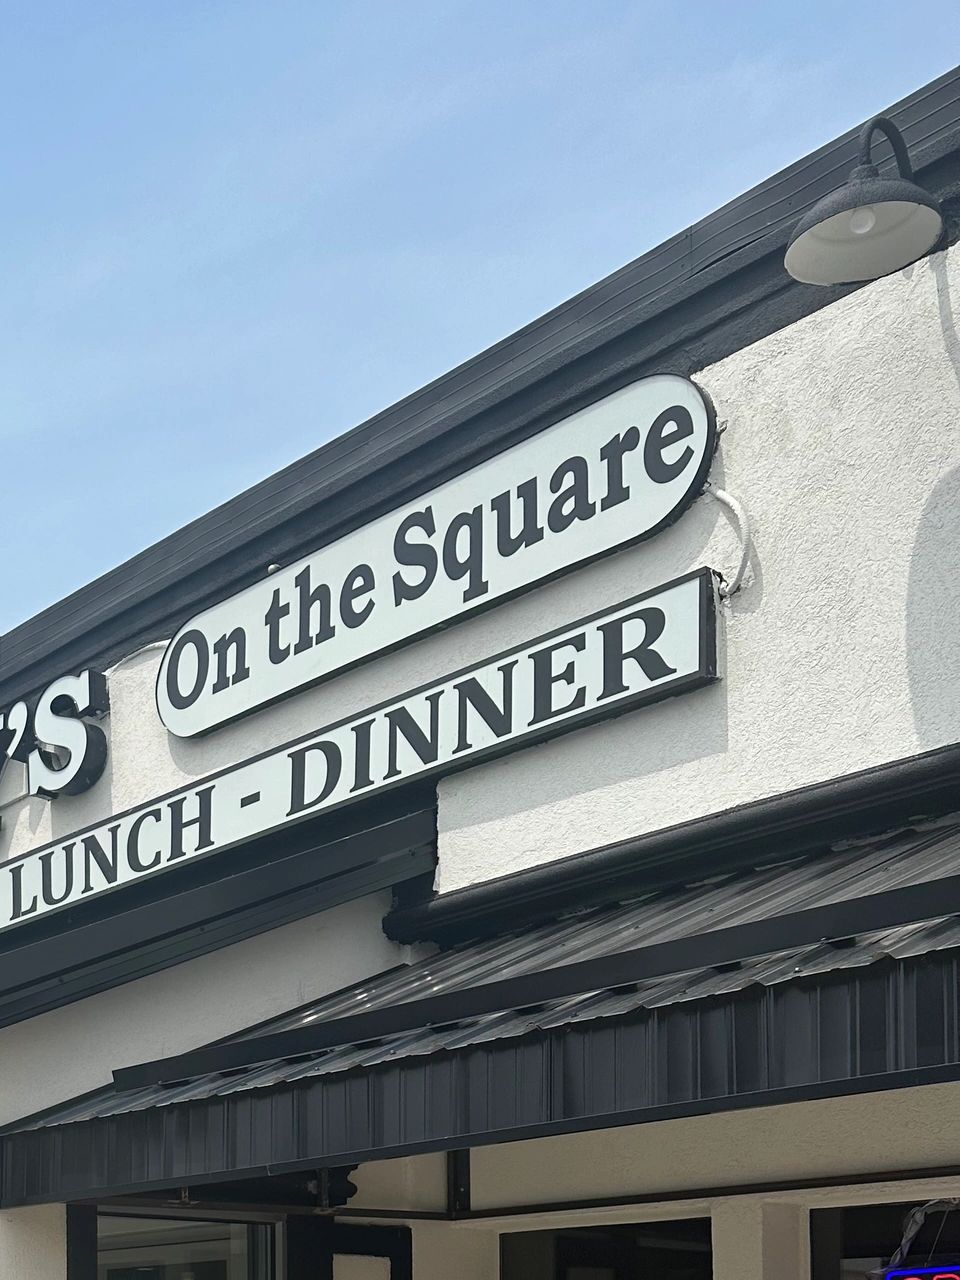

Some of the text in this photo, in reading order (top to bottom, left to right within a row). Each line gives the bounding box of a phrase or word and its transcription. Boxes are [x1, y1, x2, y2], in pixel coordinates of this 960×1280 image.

[166, 404, 694, 711] On the Square
[9, 784, 216, 922] LUNCH
[285, 606, 678, 818] DINNER
